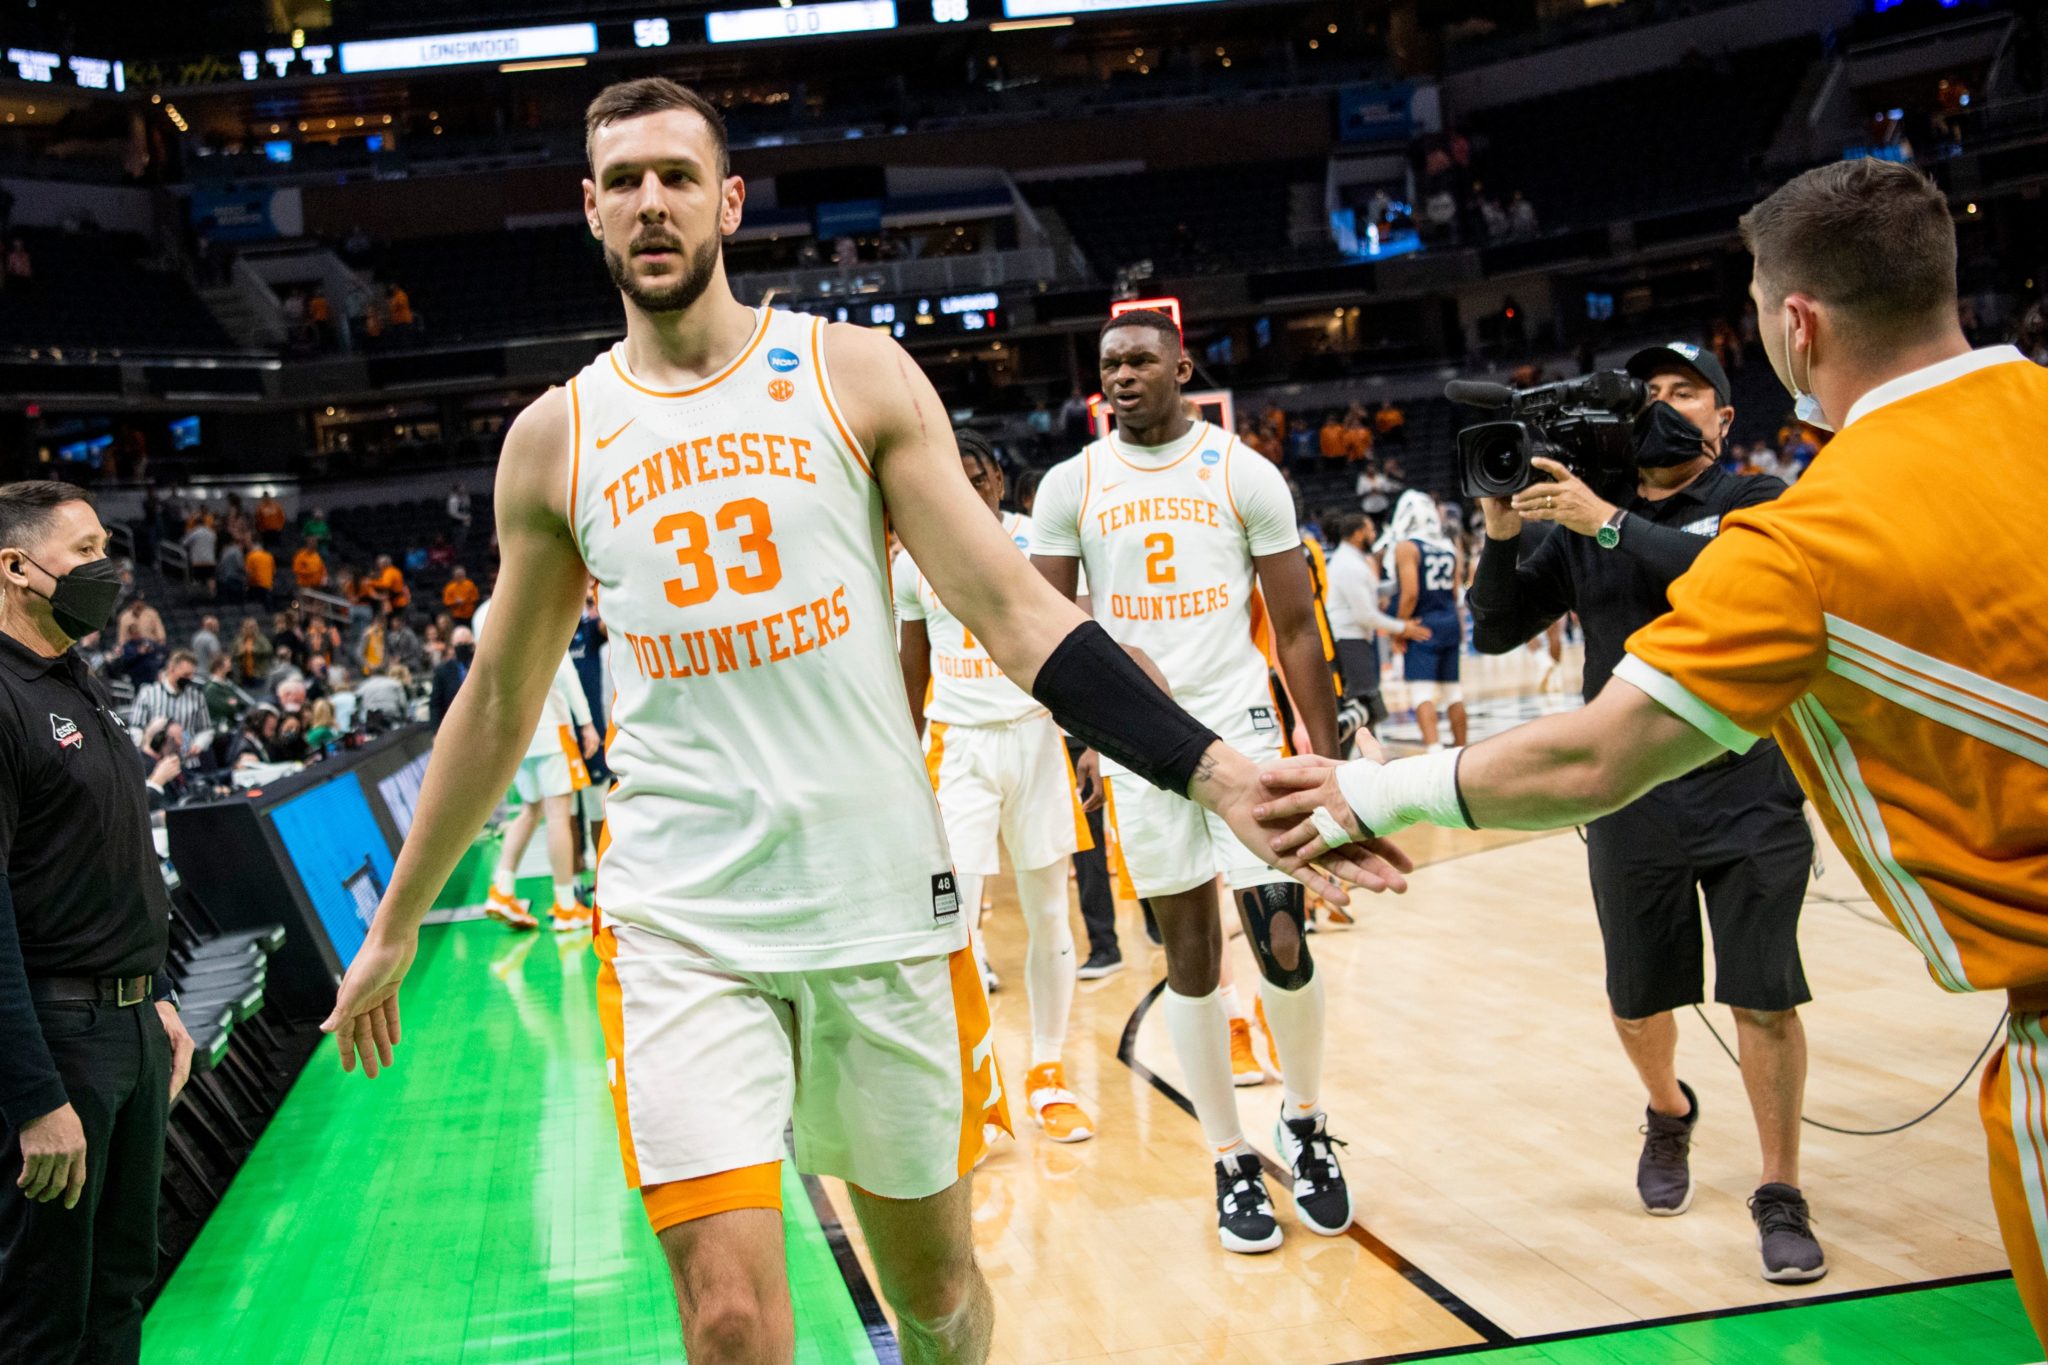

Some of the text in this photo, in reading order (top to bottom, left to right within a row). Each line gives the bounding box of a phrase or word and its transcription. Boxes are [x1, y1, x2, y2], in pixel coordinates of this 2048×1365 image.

[421, 38, 520, 62] LONGWOOD
[603, 432, 817, 529] TENNESSEE
[1097, 497, 1219, 537] TENNESSEE
[653, 497, 783, 608] 33
[1144, 532, 1176, 584] 2
[1424, 554, 1455, 591] 23
[624, 585, 851, 680] VOLUNTEERS
[938, 653, 1005, 679] VOLUNT
[937, 877, 951, 891] 48
